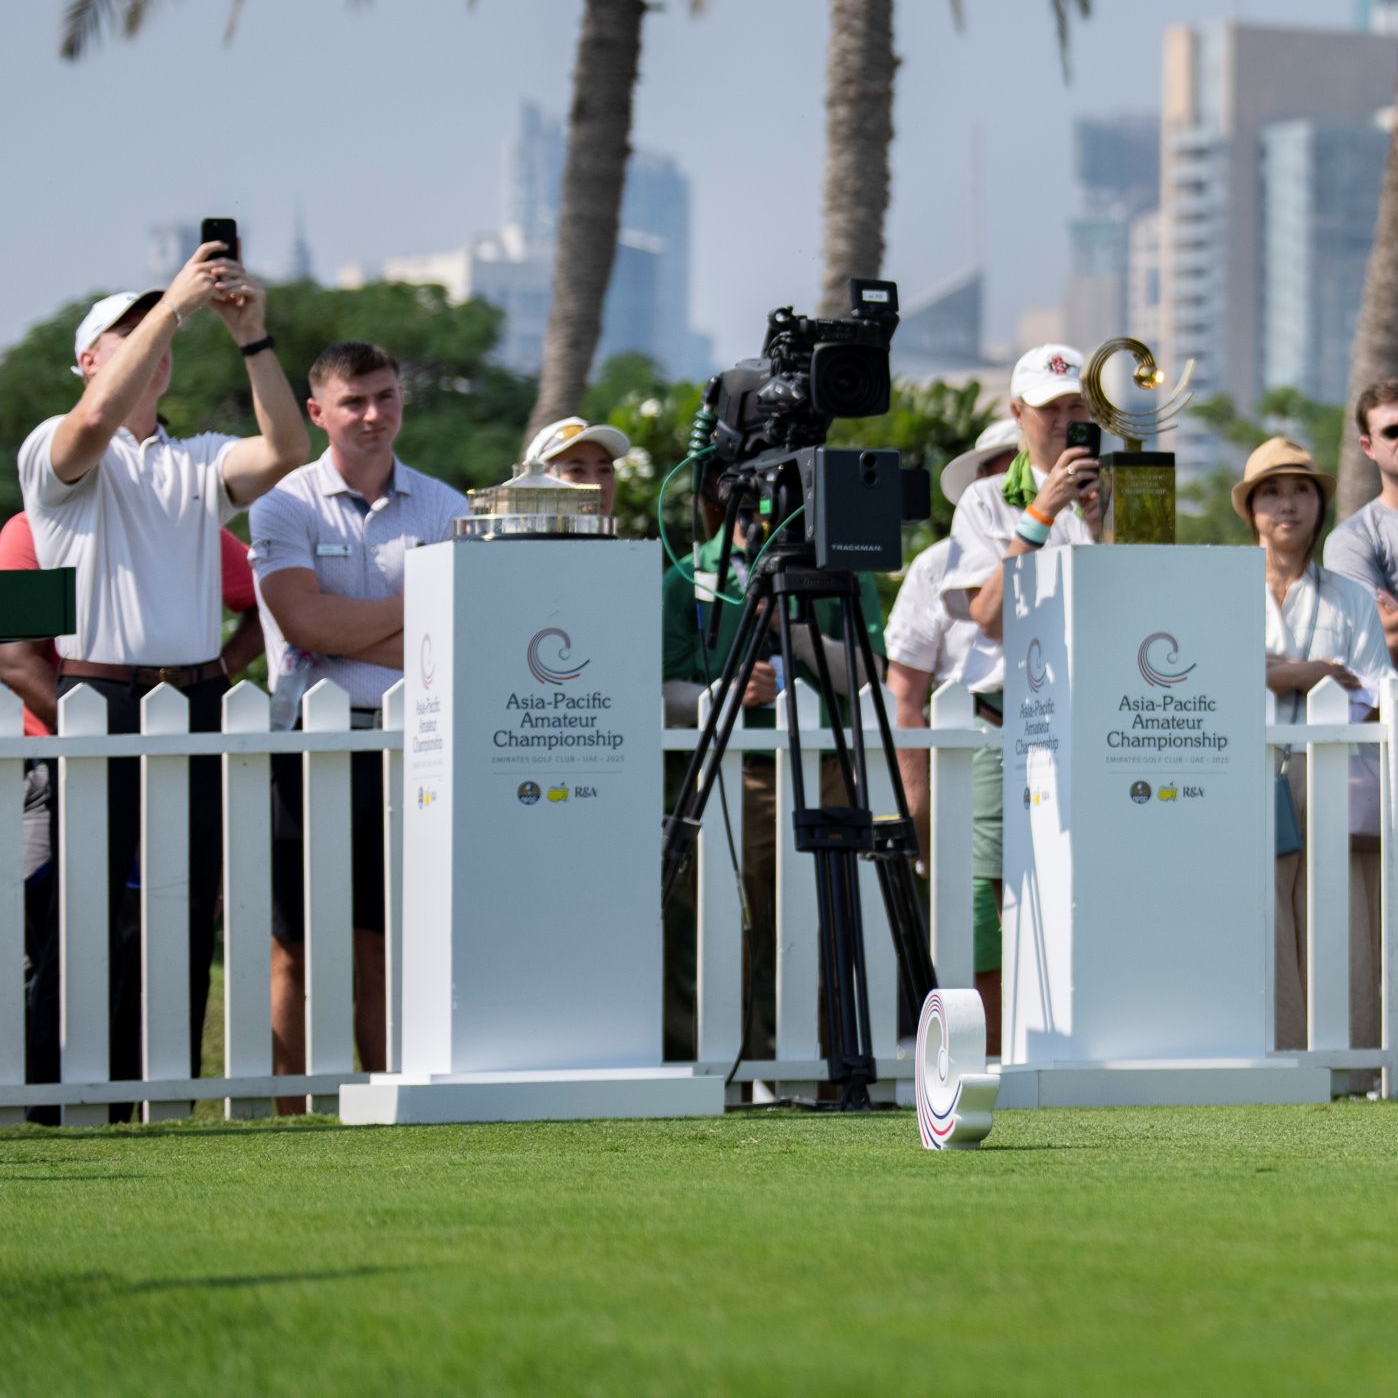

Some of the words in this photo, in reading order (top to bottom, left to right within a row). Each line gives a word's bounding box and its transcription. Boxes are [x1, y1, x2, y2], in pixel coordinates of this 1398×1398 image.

[831, 544, 881, 552] TRACKMAN
[506, 692, 611, 710] Asia-Pacific
[1019, 698, 1055, 719] Asia-Pacific
[1118, 695, 1216, 712] Asia-Pacific
[520, 712, 597, 729] Amateur
[1024, 721, 1050, 736] Amateur
[1132, 713, 1203, 730] Amateur
[493, 730, 624, 750] Championship
[1107, 731, 1228, 751] Championship
[491, 756, 530, 764] EMIRATES
[1105, 756, 1141, 764] EMIRATES
[1143, 756, 1161, 764] GOLF
[574, 786, 598, 799] R&A
[1183, 786, 1205, 798] R&A
